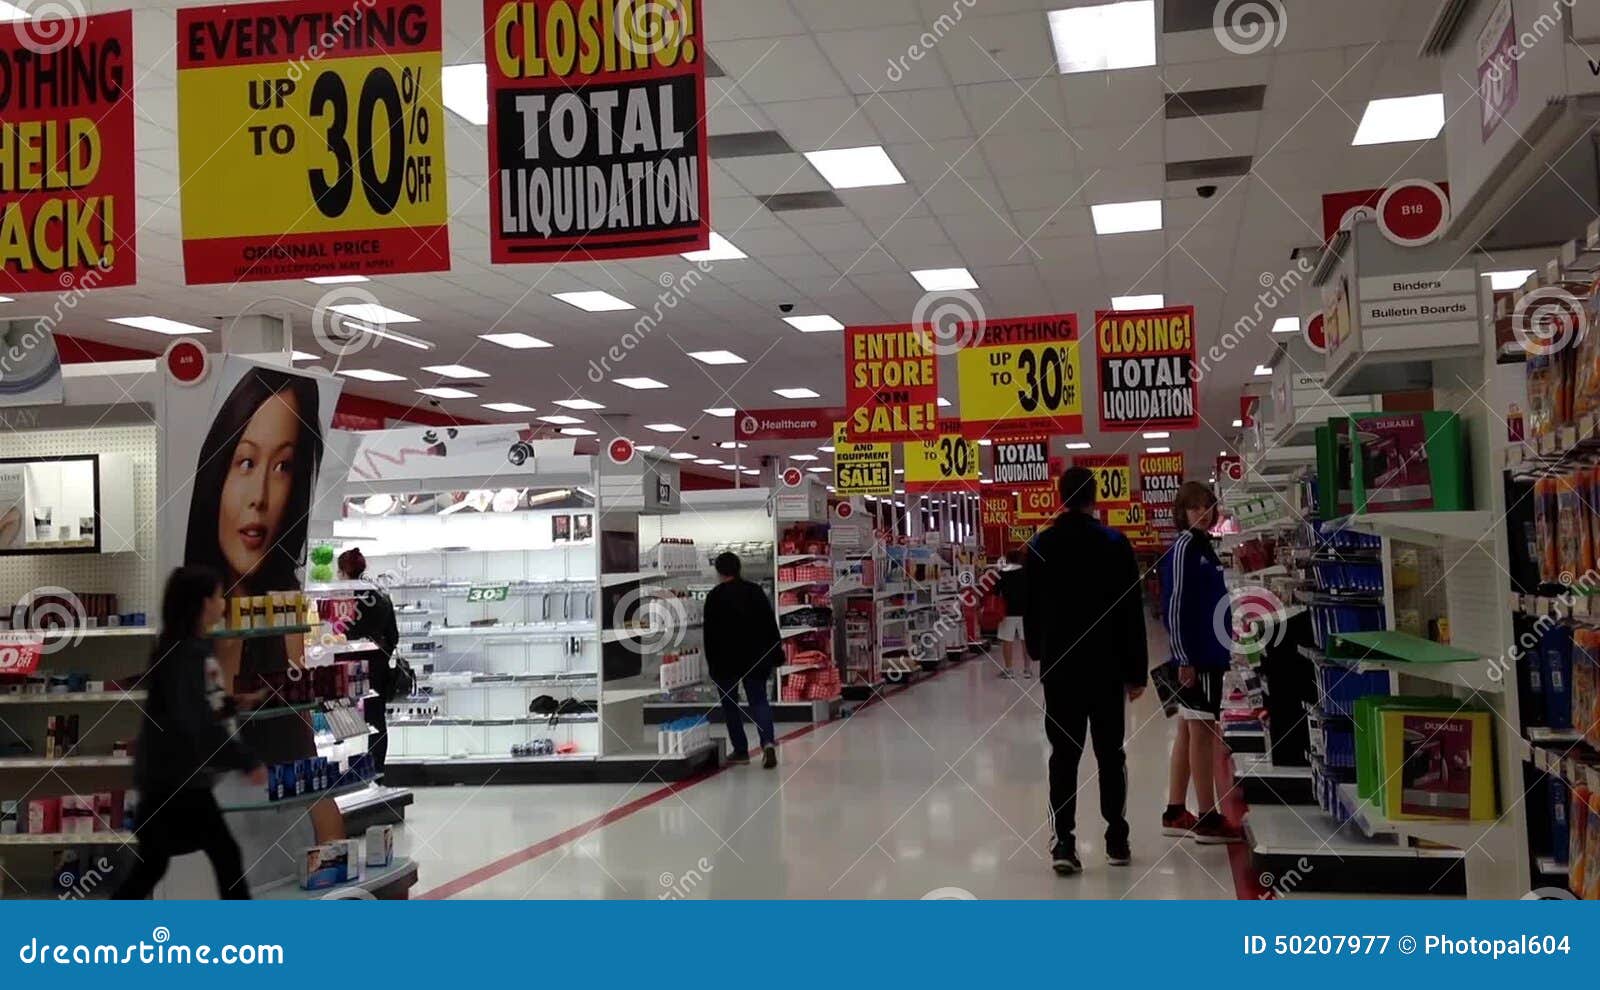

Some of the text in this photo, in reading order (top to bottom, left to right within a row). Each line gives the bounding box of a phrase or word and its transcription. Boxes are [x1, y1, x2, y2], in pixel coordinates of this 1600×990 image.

[188, 4, 428, 61] EVERYTHING
[495, 0, 695, 78] CLOSING!
[248, 79, 296, 110] UP
[515, 84, 684, 160] TOTAL
[249, 125, 296, 156] TO
[405, 156, 431, 205] OFF
[501, 155, 699, 239] LIQUIDATION
[1401, 204, 1424, 215] B18
[243, 240, 380, 261] ORIGINAL PRICE
[1393, 280, 1442, 291] Binders
[1371, 306, 1466, 318] Bulletin Boards
[962, 320, 1072, 345] VERYTHING
[1099, 314, 1191, 352] CLOSING!
[854, 331, 934, 360] ENTIRE
[990, 352, 1011, 366] UP
[854, 359, 934, 388] STORE
[991, 372, 1012, 386] TO
[1109, 355, 1187, 387] TOTAL
[1104, 387, 1194, 421] LIQUIDATION
[762, 420, 817, 430] Healthcare
[854, 403, 936, 433] SALE!
[1376, 419, 1415, 431] DURABLE
[837, 452, 888, 461] EQUIPMENT
[853, 443, 873, 451] AND
[924, 452, 937, 461] TO
[997, 443, 1044, 463] TOTAL
[994, 462, 1048, 484] LIQUIDATION
[1140, 456, 1182, 473] CLOSING!
[839, 468, 887, 487] SALE!
[1144, 475, 1180, 490] TOTAL
[986, 498, 1008, 512] HELD
[1153, 509, 1174, 519] TOTA
[983, 512, 1011, 524] BACK!
